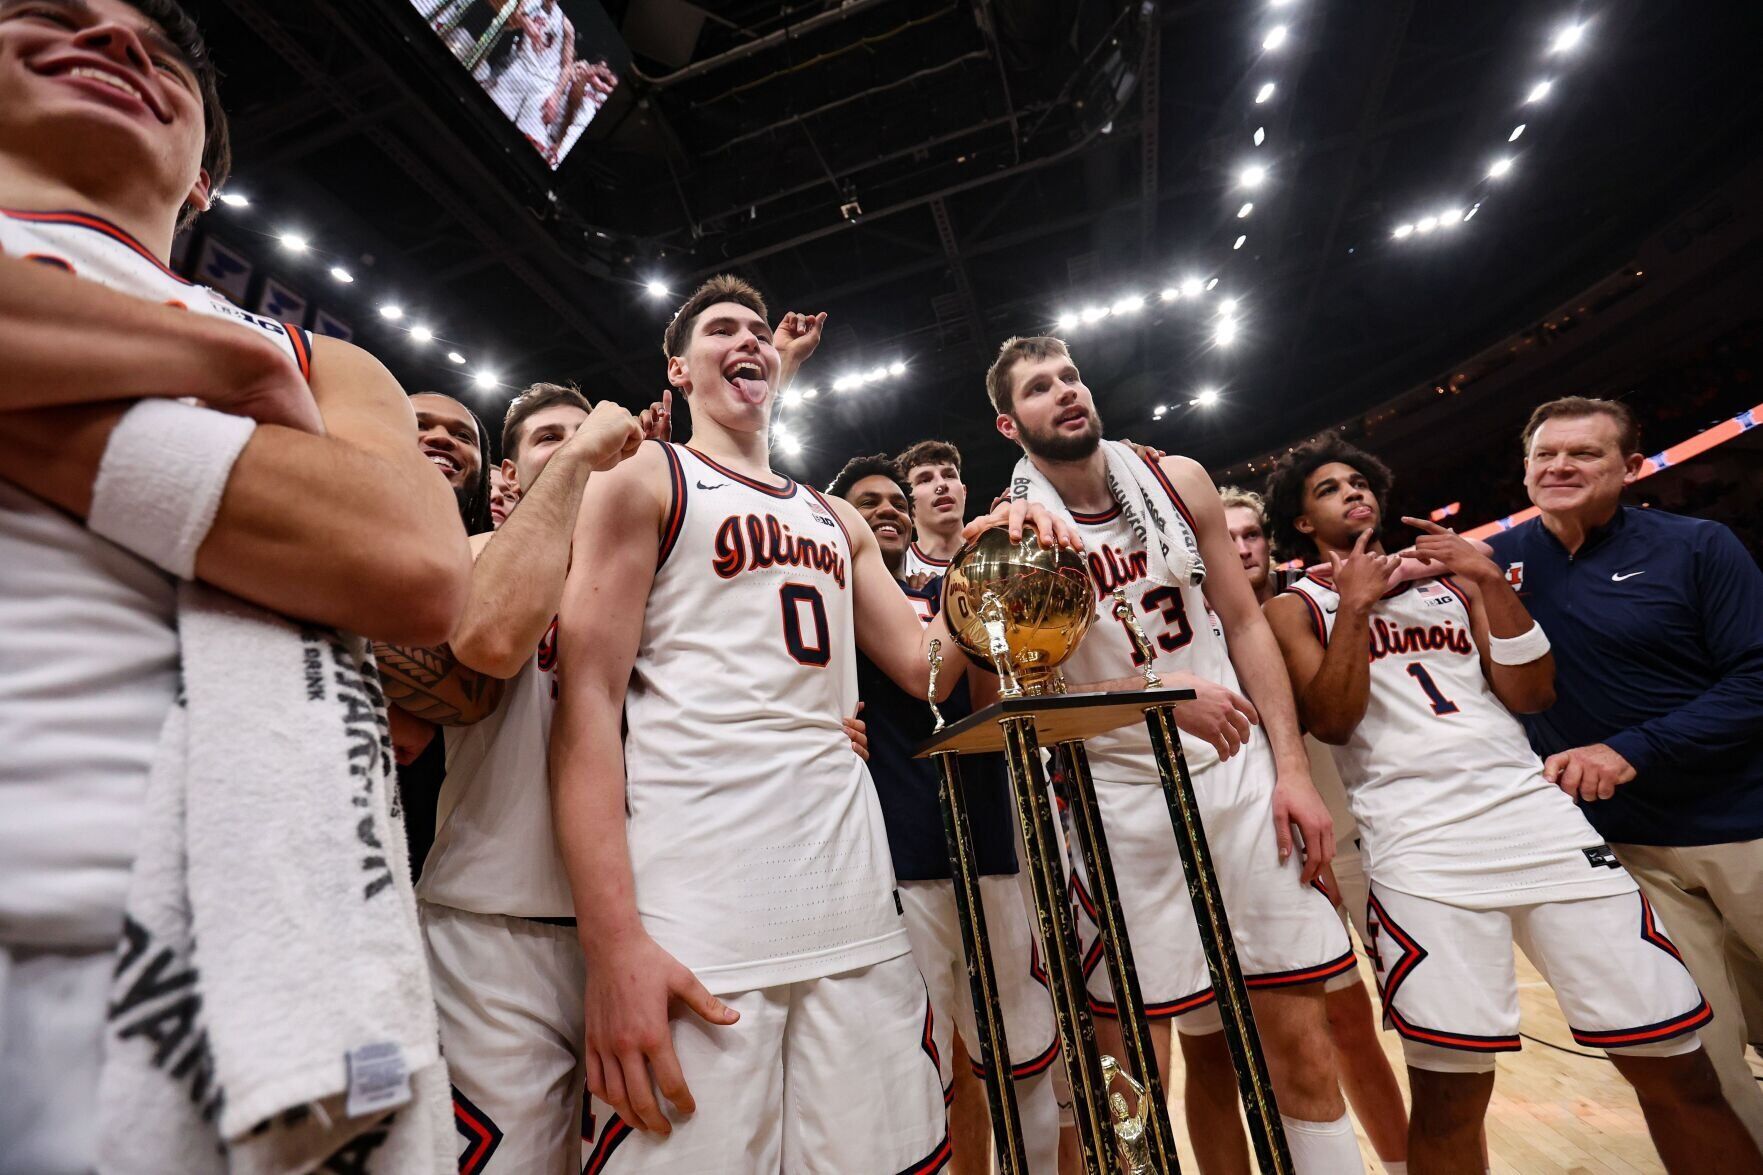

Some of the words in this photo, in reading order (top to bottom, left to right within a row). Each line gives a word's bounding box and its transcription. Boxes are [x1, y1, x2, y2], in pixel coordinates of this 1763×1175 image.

[712, 513, 846, 590] Illinois
[779, 581, 832, 668] 0
[1111, 585, 1194, 668] 13
[1406, 661, 1461, 717] 1
